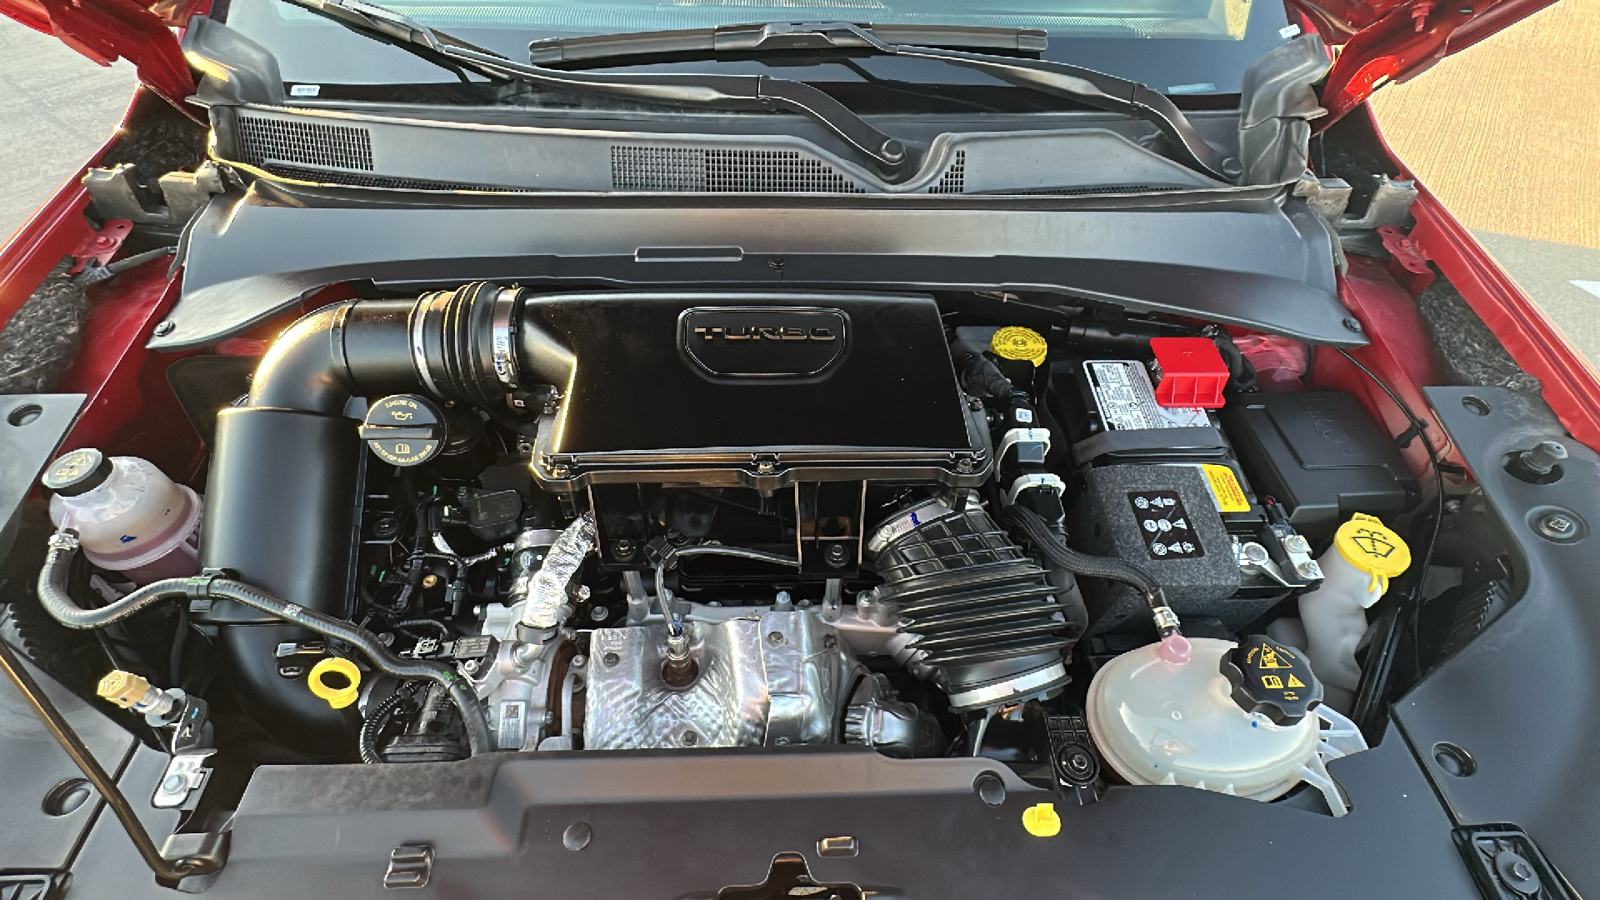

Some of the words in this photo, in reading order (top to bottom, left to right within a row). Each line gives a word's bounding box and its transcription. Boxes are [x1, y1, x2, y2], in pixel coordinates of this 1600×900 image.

[694, 326, 836, 341] TURBO
[385, 400, 408, 409] ENGINE
[408, 401, 418, 410] OIL
